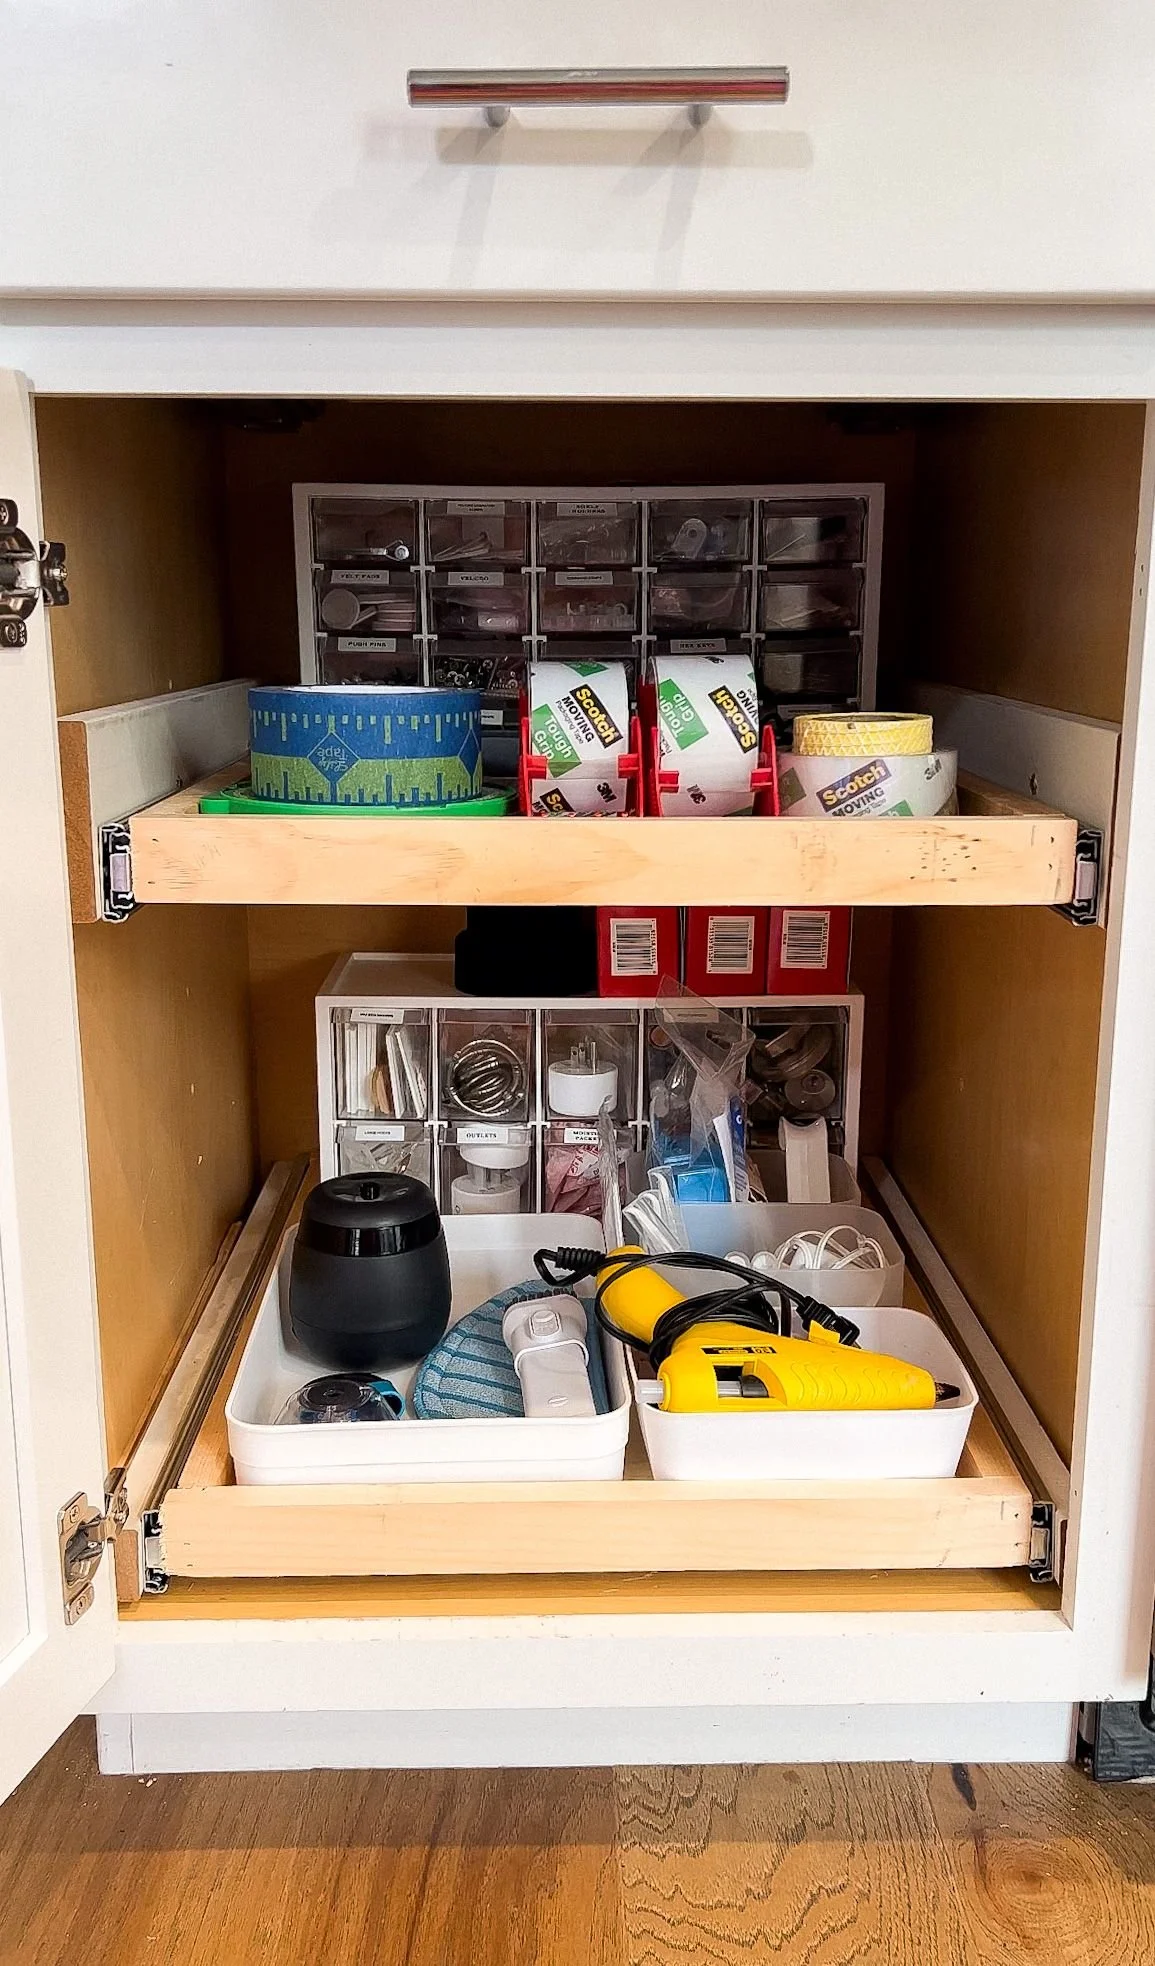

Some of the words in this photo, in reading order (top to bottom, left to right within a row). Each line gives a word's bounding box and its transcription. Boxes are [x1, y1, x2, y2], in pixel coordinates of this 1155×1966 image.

[561, 695, 595, 743] MOVING
[575, 688, 615, 744] Scotch
[673, 693, 694, 722] Grip
[714, 689, 757, 748] Scotch
[736, 690, 758, 724] VING
[534, 730, 555, 760] Grip
[544, 715, 572, 758] Tough
[316, 746, 348, 760] Tape
[597, 782, 617, 802] 3M
[686, 784, 706, 804] 3M
[822, 763, 886, 806] Scotch
[832, 787, 885, 816] MOVING
